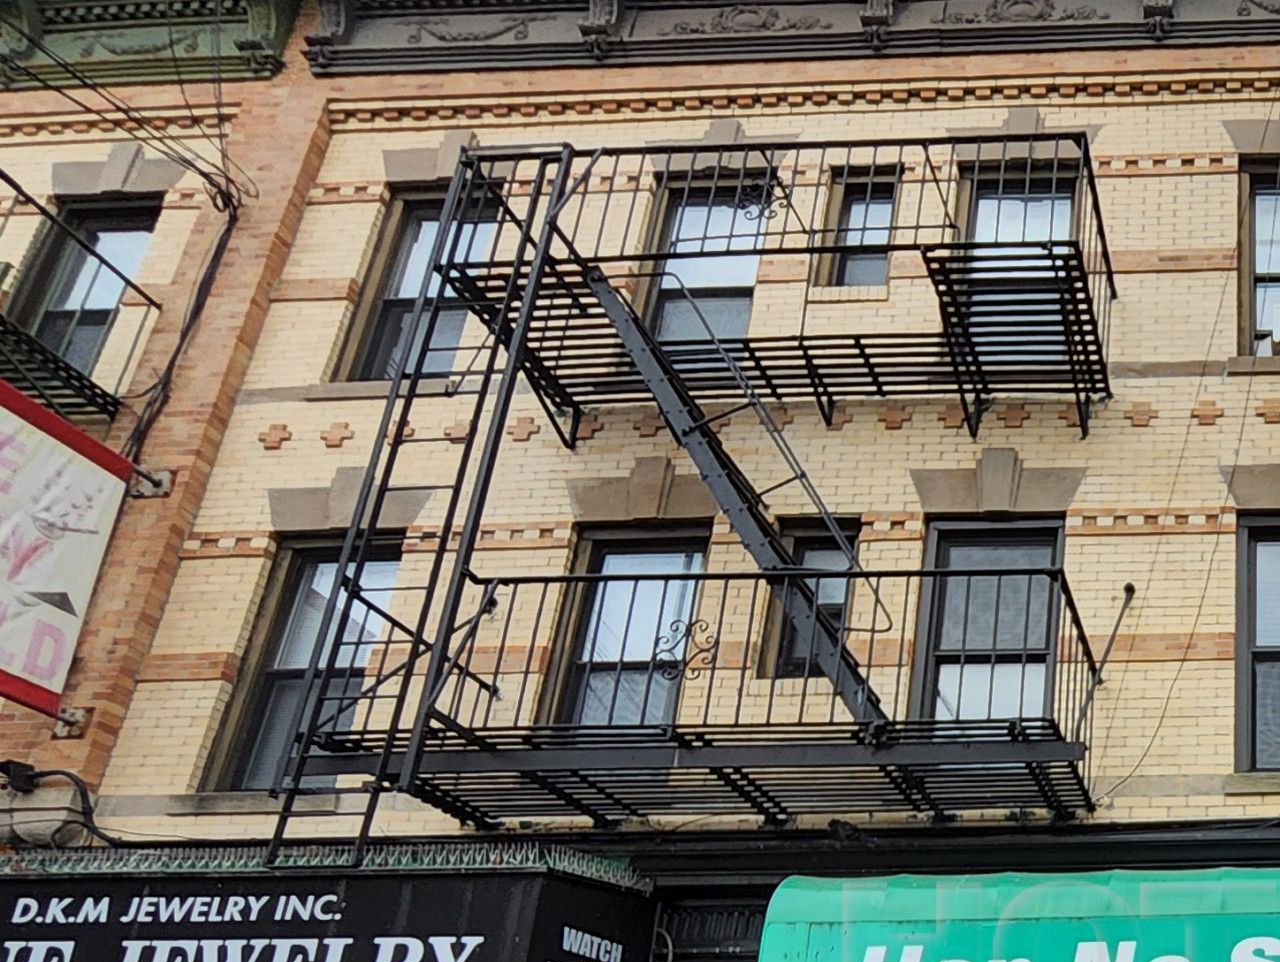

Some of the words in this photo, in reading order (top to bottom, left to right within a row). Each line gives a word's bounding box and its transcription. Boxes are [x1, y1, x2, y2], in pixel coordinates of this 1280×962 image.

[11, 897, 110, 923] D.K.M
[120, 896, 270, 923] JEWELRY
[274, 895, 344, 921] INC.
